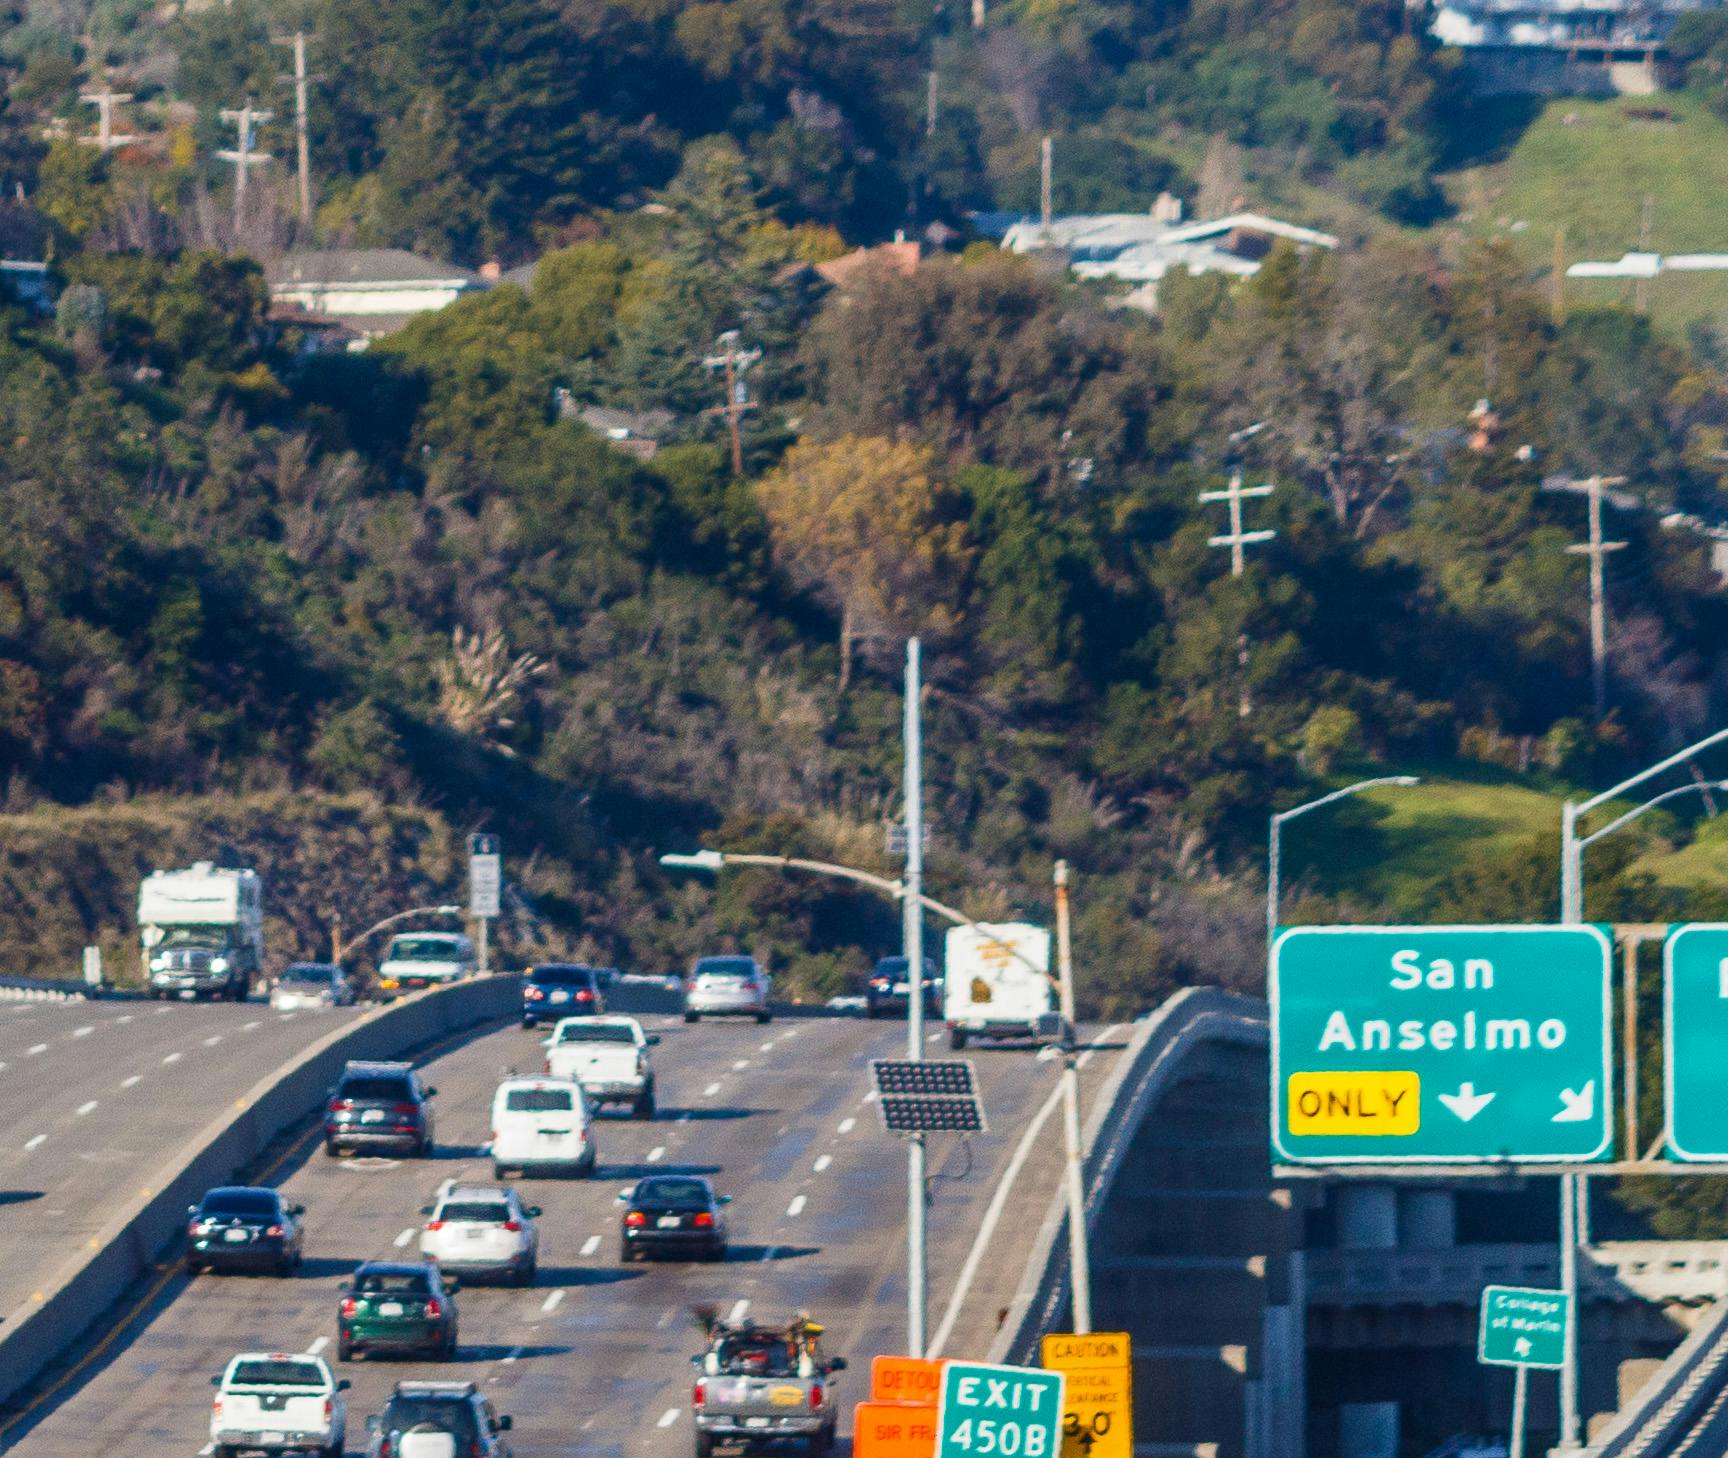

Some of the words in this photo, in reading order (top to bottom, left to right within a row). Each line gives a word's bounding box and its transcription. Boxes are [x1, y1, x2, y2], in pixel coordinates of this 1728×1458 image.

[1390, 949, 1495, 991] San
[1318, 1010, 1567, 1051] Anselmo
[1298, 1089, 1408, 1119] ONLY
[1053, 1341, 1120, 1359] CAUTION
[882, 1370, 940, 1389] DETOU
[956, 1376, 1049, 1411] EXIT
[875, 1424, 905, 1440] SIR
[949, 1418, 1047, 1457] 450B
